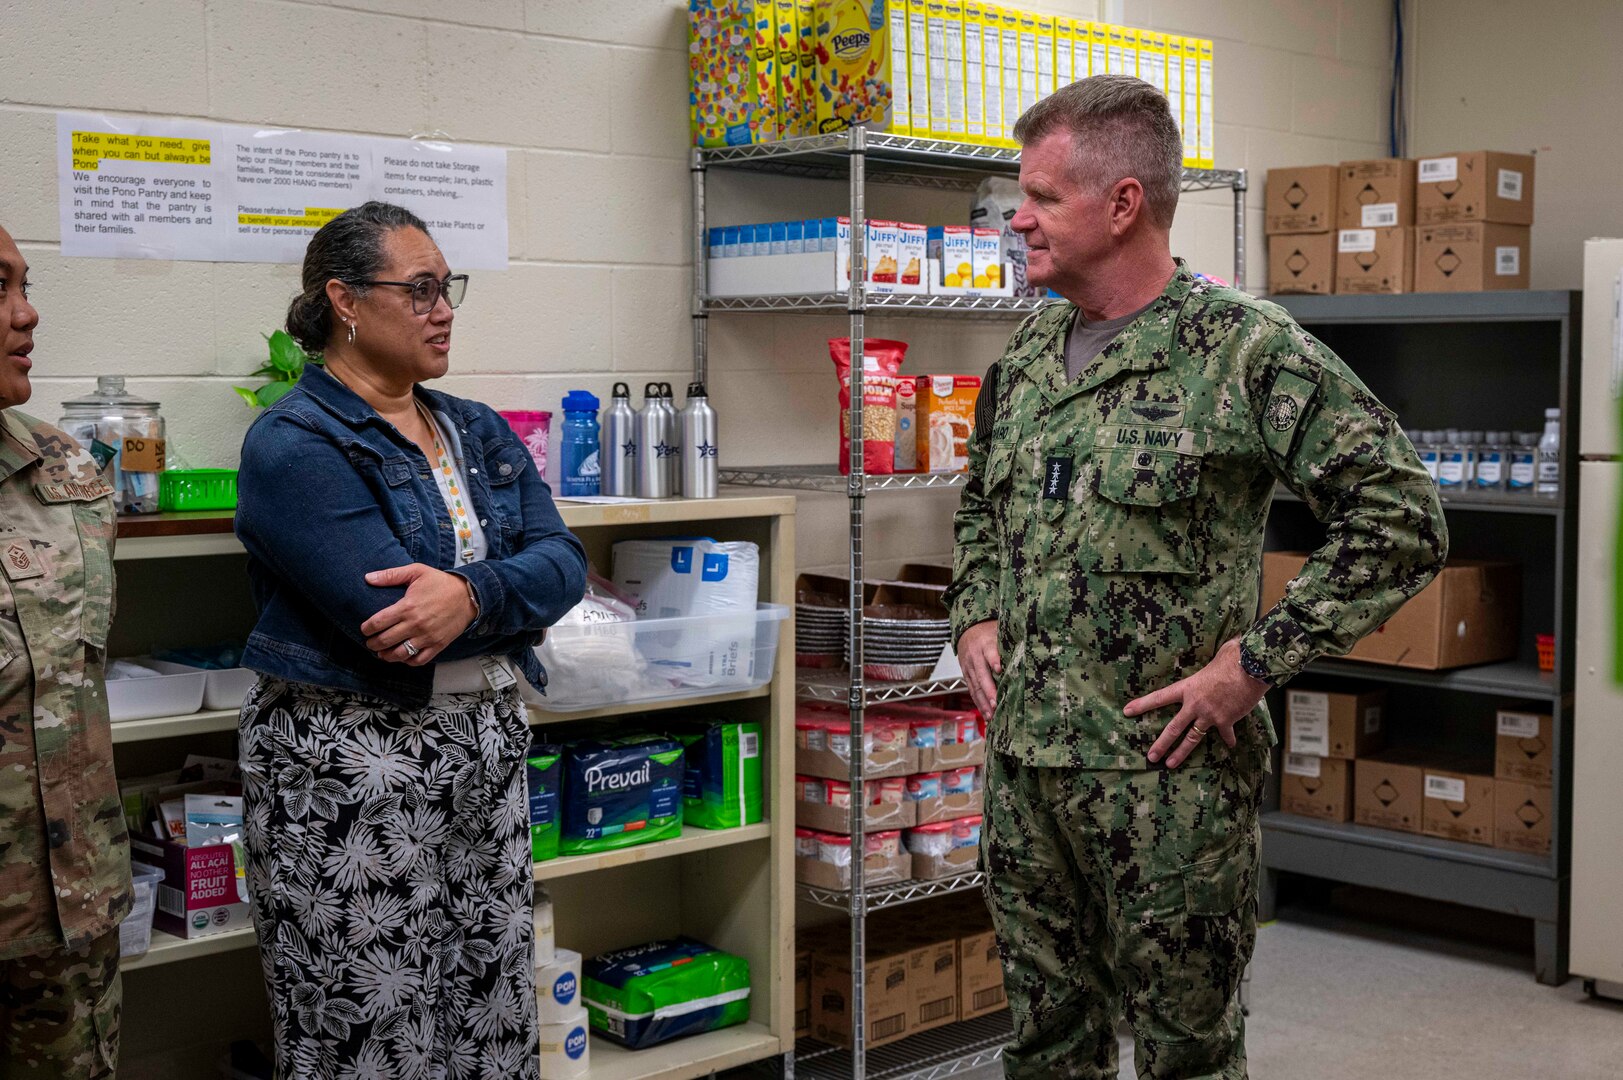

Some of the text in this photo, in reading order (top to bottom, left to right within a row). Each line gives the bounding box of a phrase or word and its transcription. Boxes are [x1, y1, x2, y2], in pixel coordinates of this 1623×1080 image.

[832, 33, 870, 52] Peeps
[107, 136, 129, 146] what
[136, 139, 152, 148] you
[160, 139, 185, 150] need,
[192, 142, 210, 152] give
[73, 147, 210, 163] when you can but always be
[253, 146, 272, 154] intent
[285, 148, 296, 156] the
[299, 149, 317, 157] Pono
[319, 151, 341, 160] pantry
[237, 155, 252, 163] help
[269, 157, 293, 167] military
[295, 160, 327, 168] members
[329, 161, 342, 169] and
[345, 162, 359, 170] their
[384, 157, 408, 166] Please
[409, 159, 419, 167] do
[421, 160, 433, 168] not
[453, 162, 480, 172] Storage
[237, 165, 265, 174] families.
[269, 167, 292, 175] Please
[306, 170, 345, 179] considerate
[73, 173, 211, 188] We encourage everyone to
[273, 177, 291, 185] 2000
[293, 179, 316, 187] HIANG
[318, 181, 352, 190] members)
[384, 171, 405, 180] items
[406, 172, 417, 181] for
[471, 178, 494, 186] plastic
[74, 185, 211, 201] visit the Pono Pantry and keep
[384, 186, 425, 197] containers,
[74, 198, 212, 214] in mind that the pantry is
[238, 205, 262, 213] Please
[74, 211, 212, 225] shared with all members and
[248, 216, 271, 224] benefit
[292, 218, 322, 227] personal
[75, 224, 136, 234] their families.
[454, 221, 475, 230] Plants
[273, 228, 302, 236] personal
[871, 230, 897, 242] JIFFY
[900, 232, 926, 244] JIFFY
[945, 237, 970, 247] JIFFY
[973, 239, 998, 249] JIFFY
[1117, 429, 1183, 447] U.S. NAVY
[126, 440, 144, 452] DO
[677, 551, 685, 563] L
[706, 563, 719, 572] L
[728, 641, 738, 676] Briefs
[585, 760, 650, 792] Prevail
[586, 828, 595, 838] 22
[190, 852, 229, 861] ABSOLUTELY
[191, 861, 206, 870] ALL
[190, 867, 229, 879] NO OTHER
[191, 876, 228, 891] FRUIT
